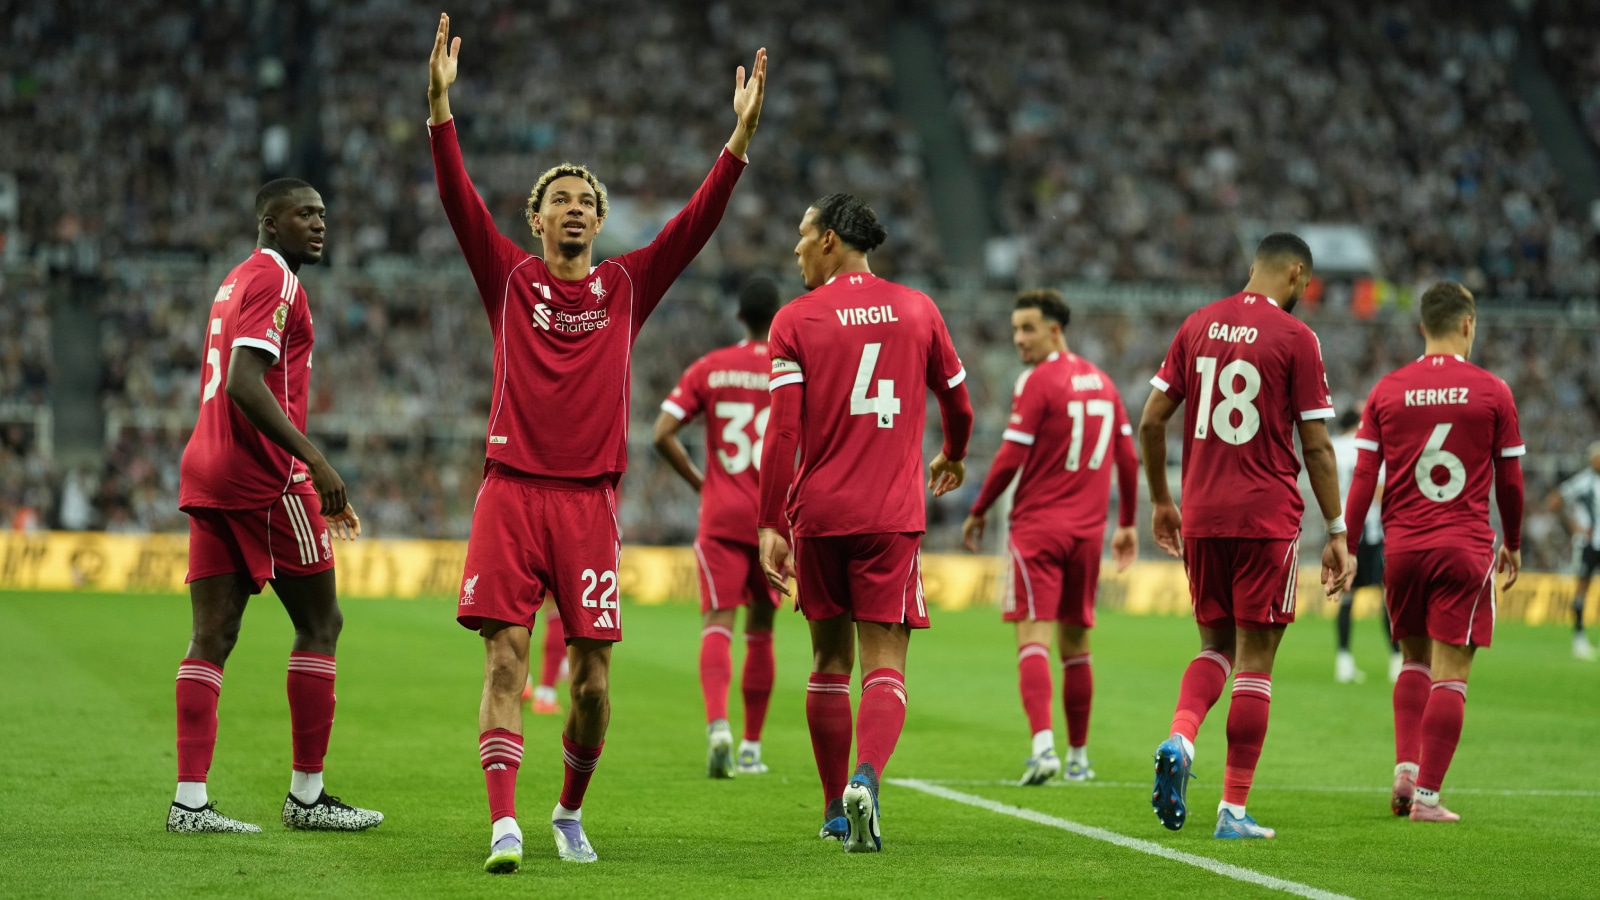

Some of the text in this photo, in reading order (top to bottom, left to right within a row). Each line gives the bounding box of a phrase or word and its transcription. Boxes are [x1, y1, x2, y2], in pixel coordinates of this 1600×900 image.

[554, 317, 611, 333] chartered
[555, 307, 607, 323] standard
[835, 305, 899, 326] VIRGIL
[1208, 321, 1259, 344] GAKPO
[203, 318, 223, 405] 5
[849, 342, 901, 429] 4
[1194, 355, 1262, 446] 18
[1405, 387, 1470, 407] KERKEZ
[1064, 399, 1115, 472] 17
[1414, 422, 1467, 503] 6
[581, 568, 617, 609] 22
